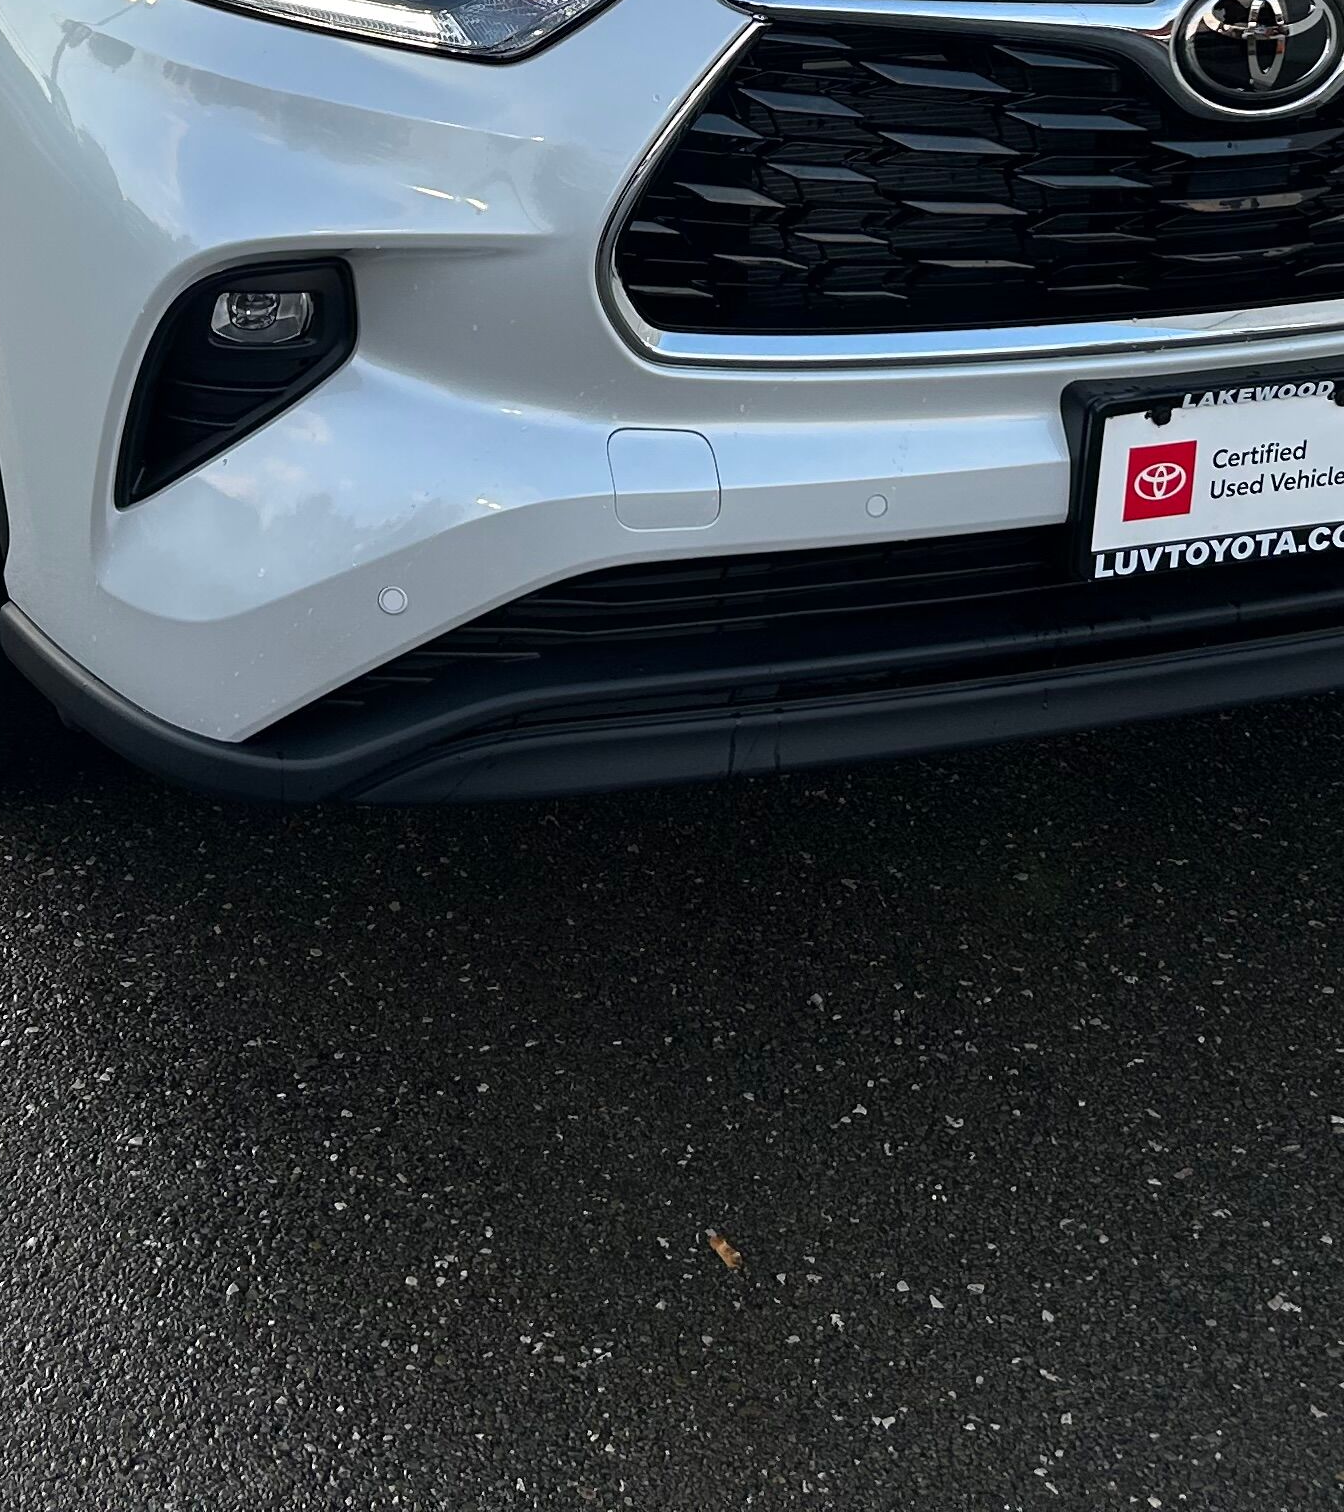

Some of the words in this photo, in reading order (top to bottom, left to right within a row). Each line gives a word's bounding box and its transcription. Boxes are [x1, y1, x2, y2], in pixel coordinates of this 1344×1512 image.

[1182, 380, 1335, 409] LAKEWOOD
[1212, 439, 1307, 469] Certified
[1209, 472, 1263, 499] Used
